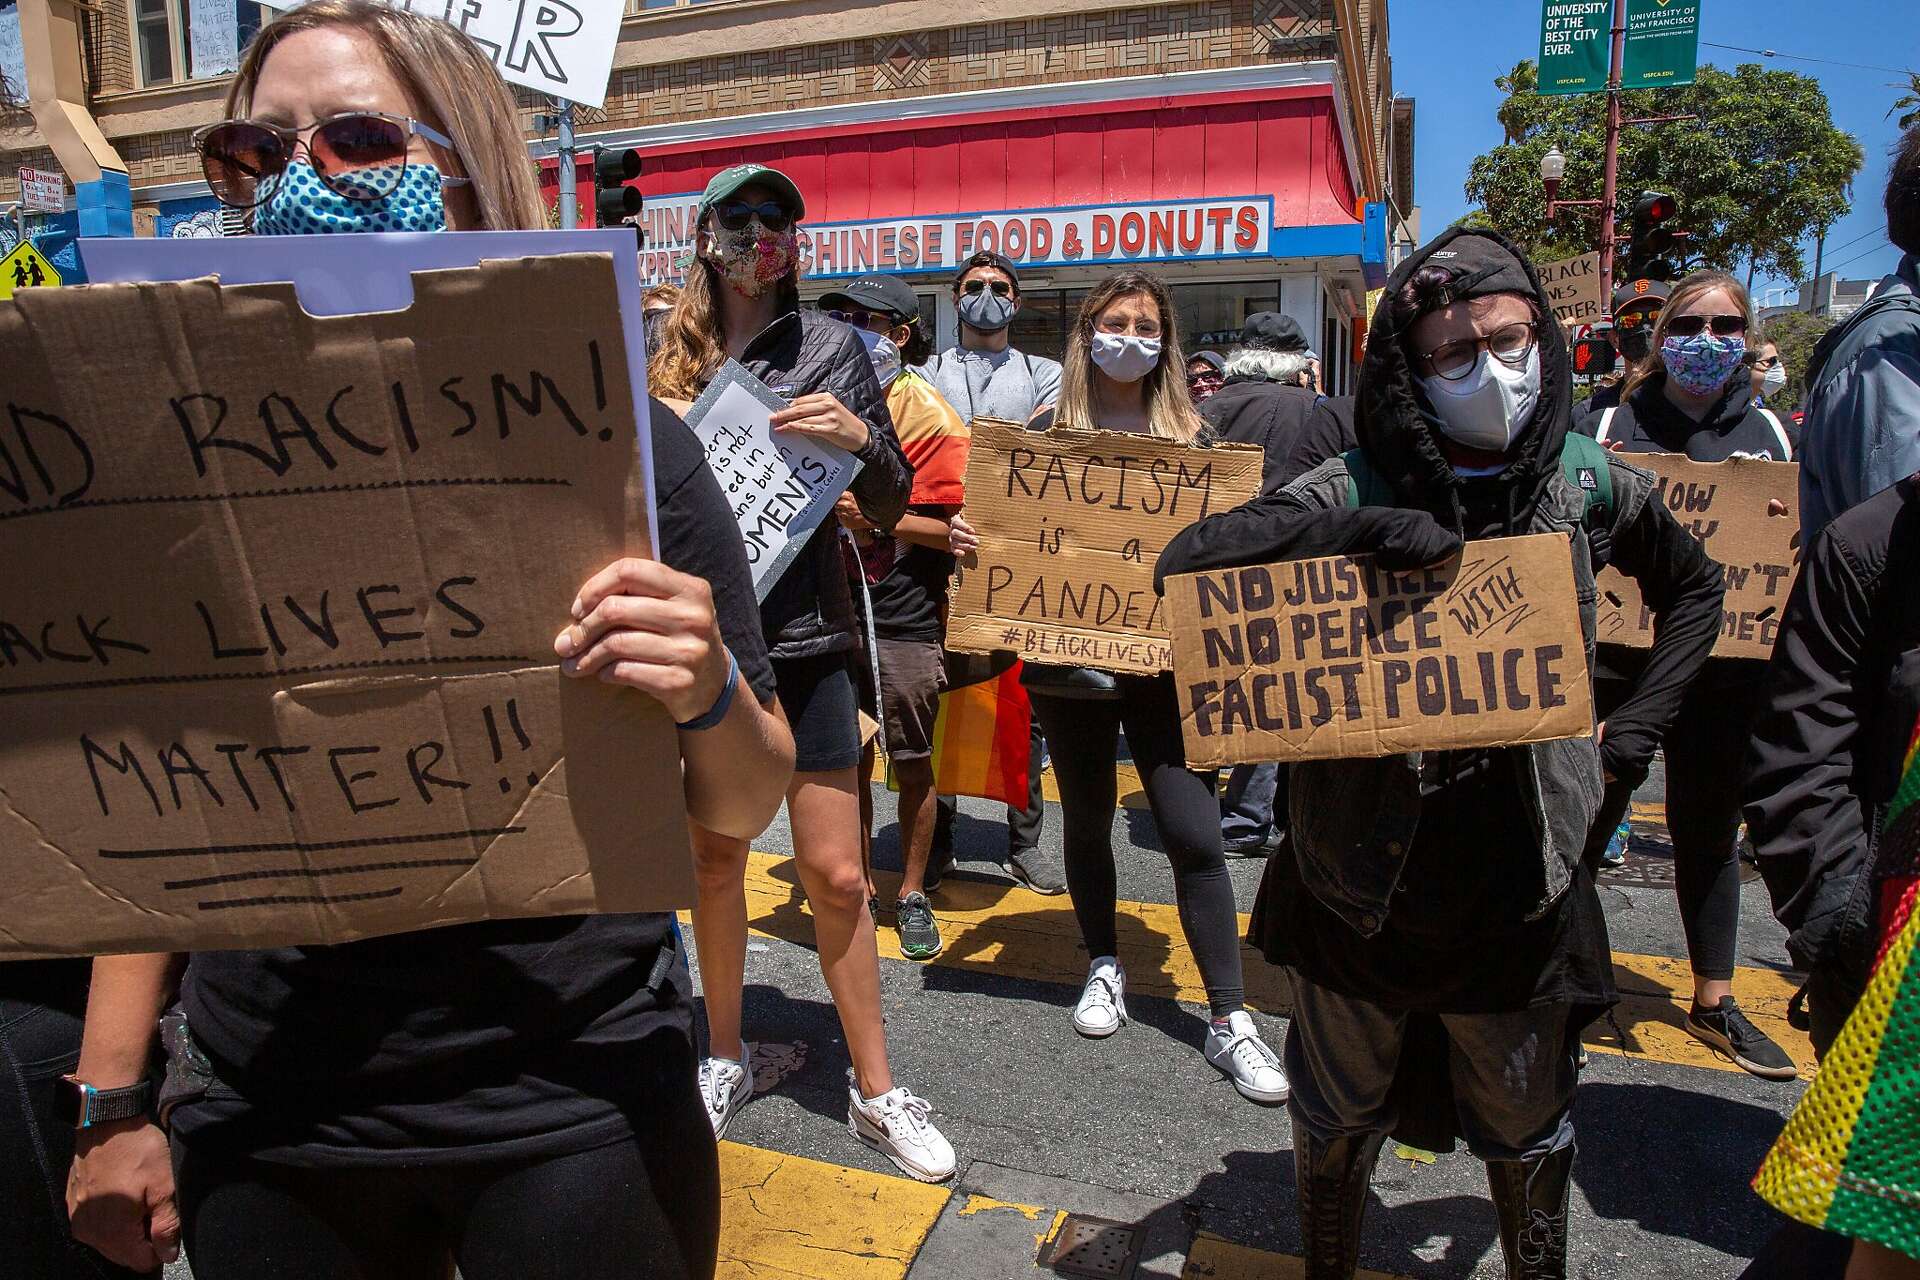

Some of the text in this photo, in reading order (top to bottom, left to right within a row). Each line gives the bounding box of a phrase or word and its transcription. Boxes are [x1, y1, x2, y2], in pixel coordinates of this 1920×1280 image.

[1546, 17, 1584, 30] OF THE
[1547, 3, 1608, 17] UNIVERSITY
[1630, 7, 1696, 21] UNIVERSITY OF
[1630, 16, 1695, 30] SAN FRANCISCO
[1544, 44, 1574, 56] EVER.
[1545, 28, 1599, 43] BEST CITY
[21, 168, 61, 186] NO PARKING
[639, 204, 698, 244] HINA
[797, 206, 1259, 271] CHINESE FOOD & DONUTS
[1537, 259, 1595, 287] BLACK
[169, 340, 614, 478] RACISM!
[712, 424, 753, 473] is not
[743, 447, 765, 468] in
[754, 462, 775, 490] but
[774, 445, 793, 464] in
[1007, 447, 1213, 520] RACISM
[1039, 517, 1141, 564] is a
[1196, 566, 1275, 618] NO
[1448, 566, 1524, 637] WITH
[196, 576, 485, 659] LIVES
[1202, 596, 1443, 668] NO PEACE
[1189, 644, 1567, 736] FACIST POLICE
